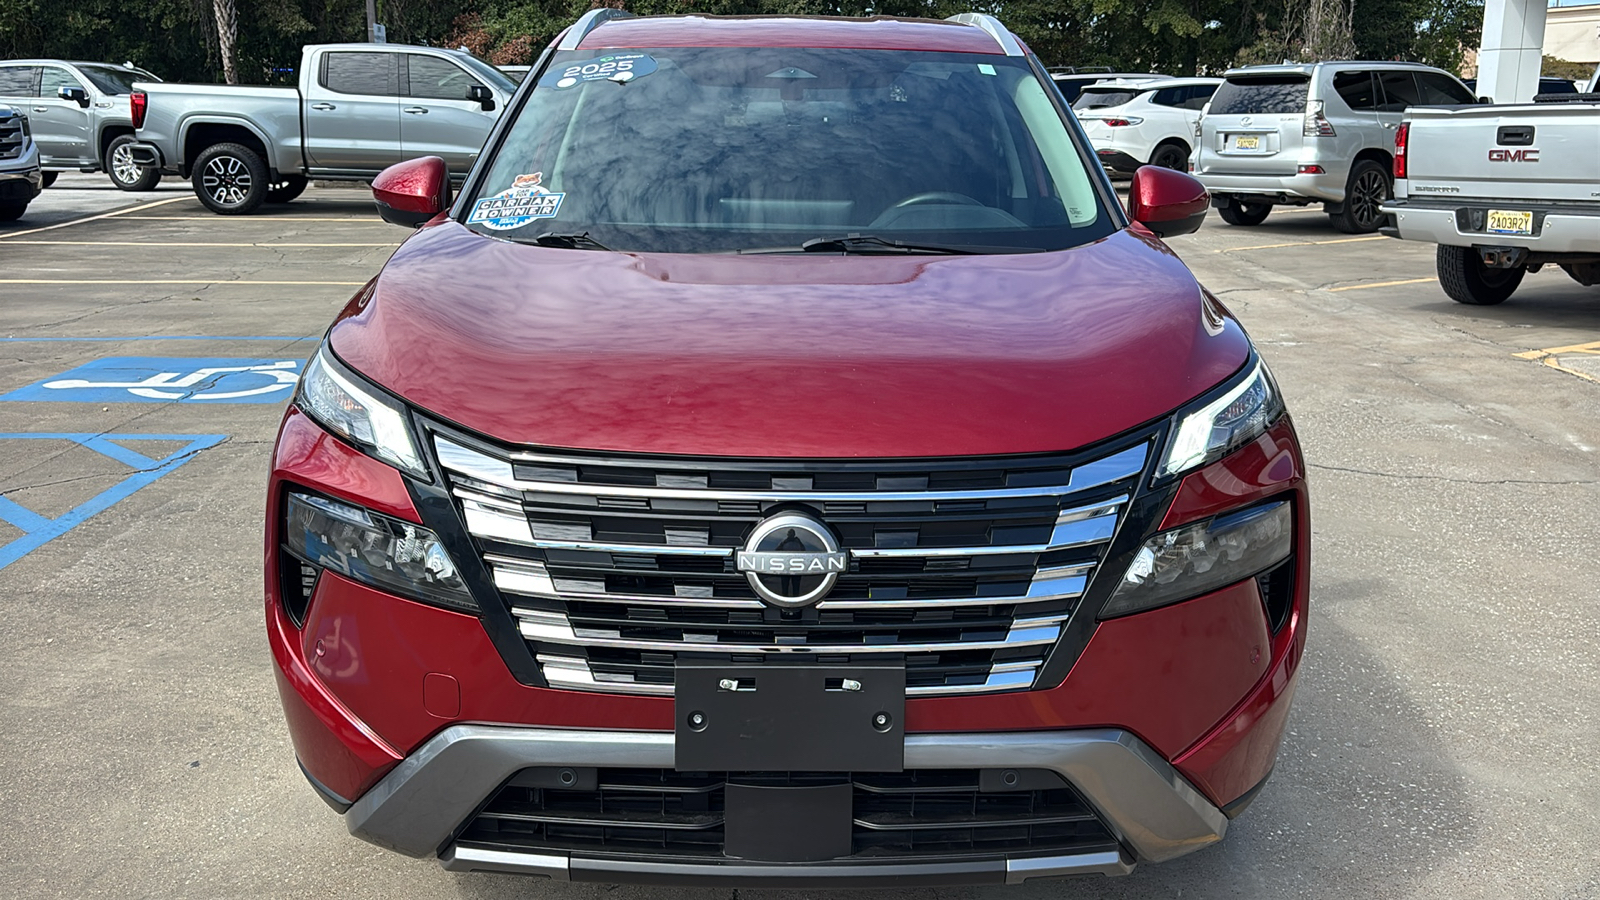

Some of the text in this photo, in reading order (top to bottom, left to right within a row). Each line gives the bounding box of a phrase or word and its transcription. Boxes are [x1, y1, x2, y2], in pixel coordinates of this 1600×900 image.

[563, 60, 634, 78] 2025
[1488, 149, 1540, 163] GMC
[480, 198, 556, 210] CARFAX
[488, 206, 552, 217] OWNER
[1490, 216, 1530, 231] 2A03R2Y
[740, 555, 844, 571] NISSAN
